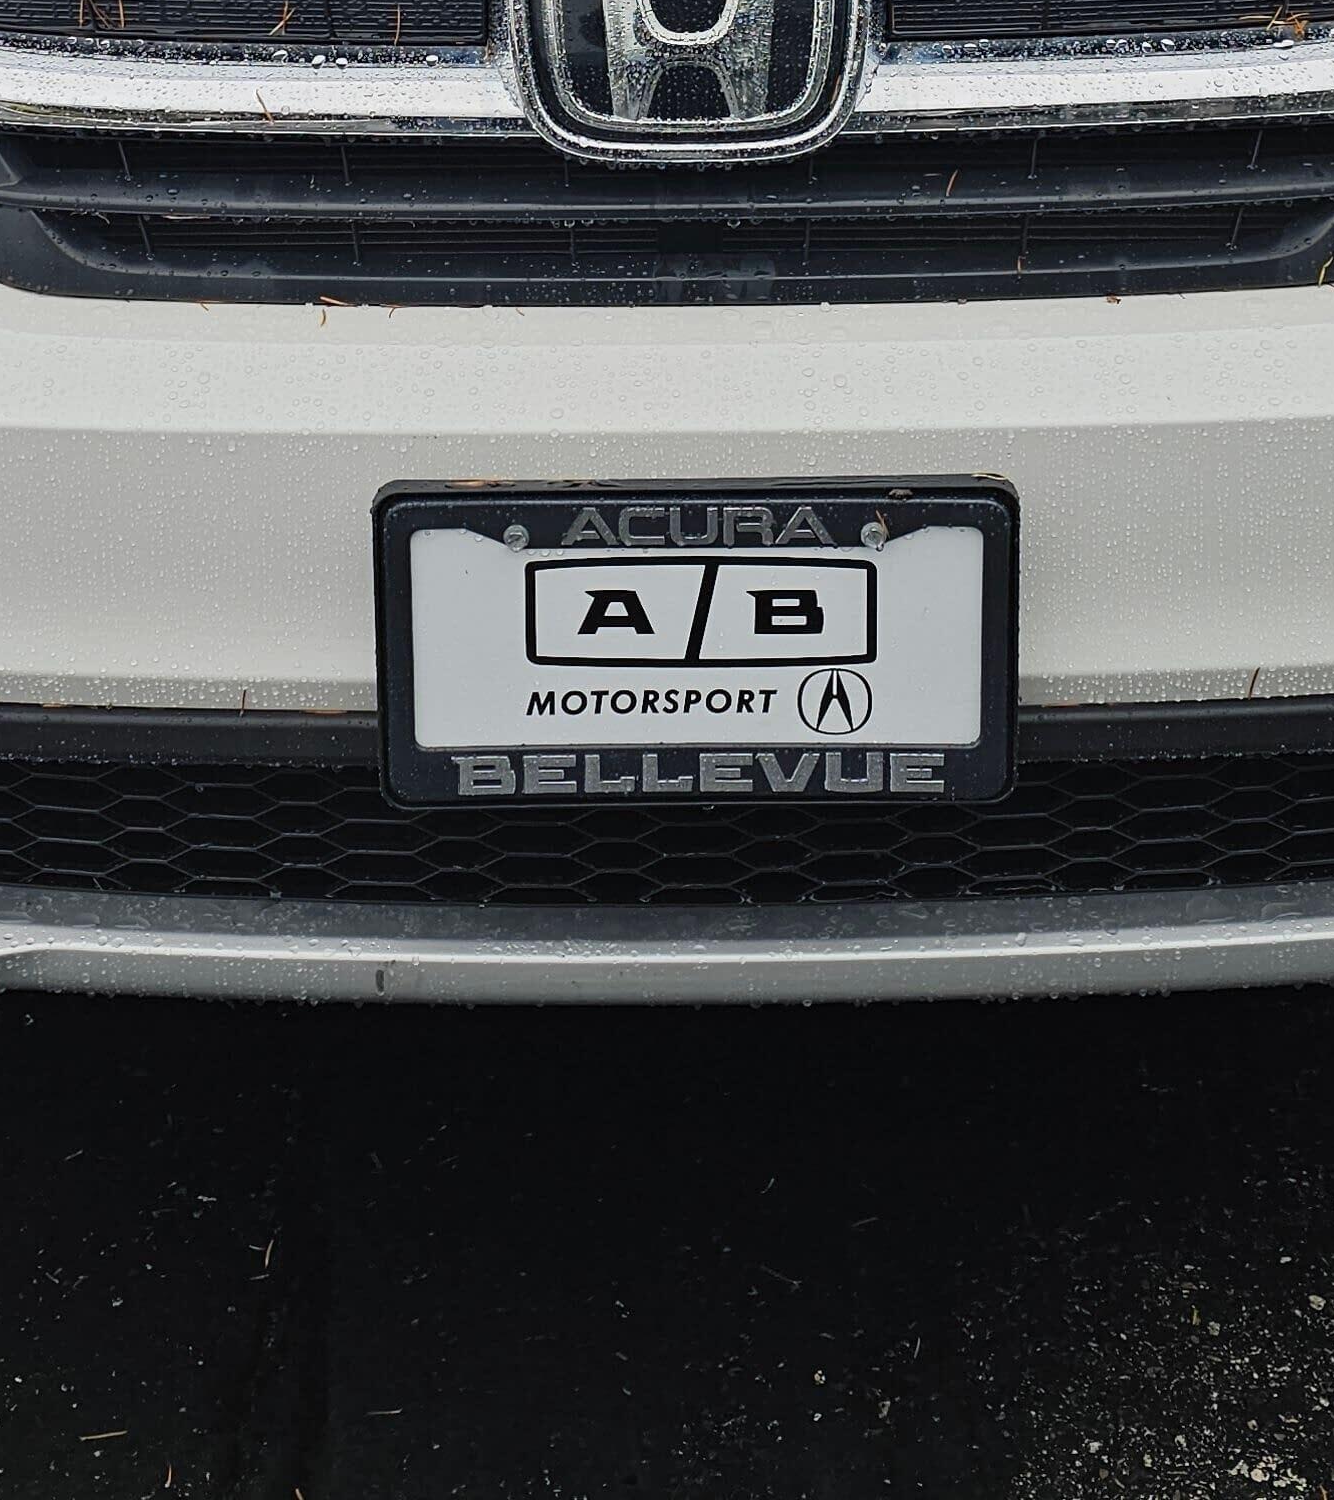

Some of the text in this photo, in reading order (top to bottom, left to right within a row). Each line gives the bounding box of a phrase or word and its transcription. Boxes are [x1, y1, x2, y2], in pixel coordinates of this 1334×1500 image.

[560, 505, 837, 548] ACURA
[525, 688, 779, 717] MOTORSPORT
[451, 752, 945, 796] BELLEVUE
